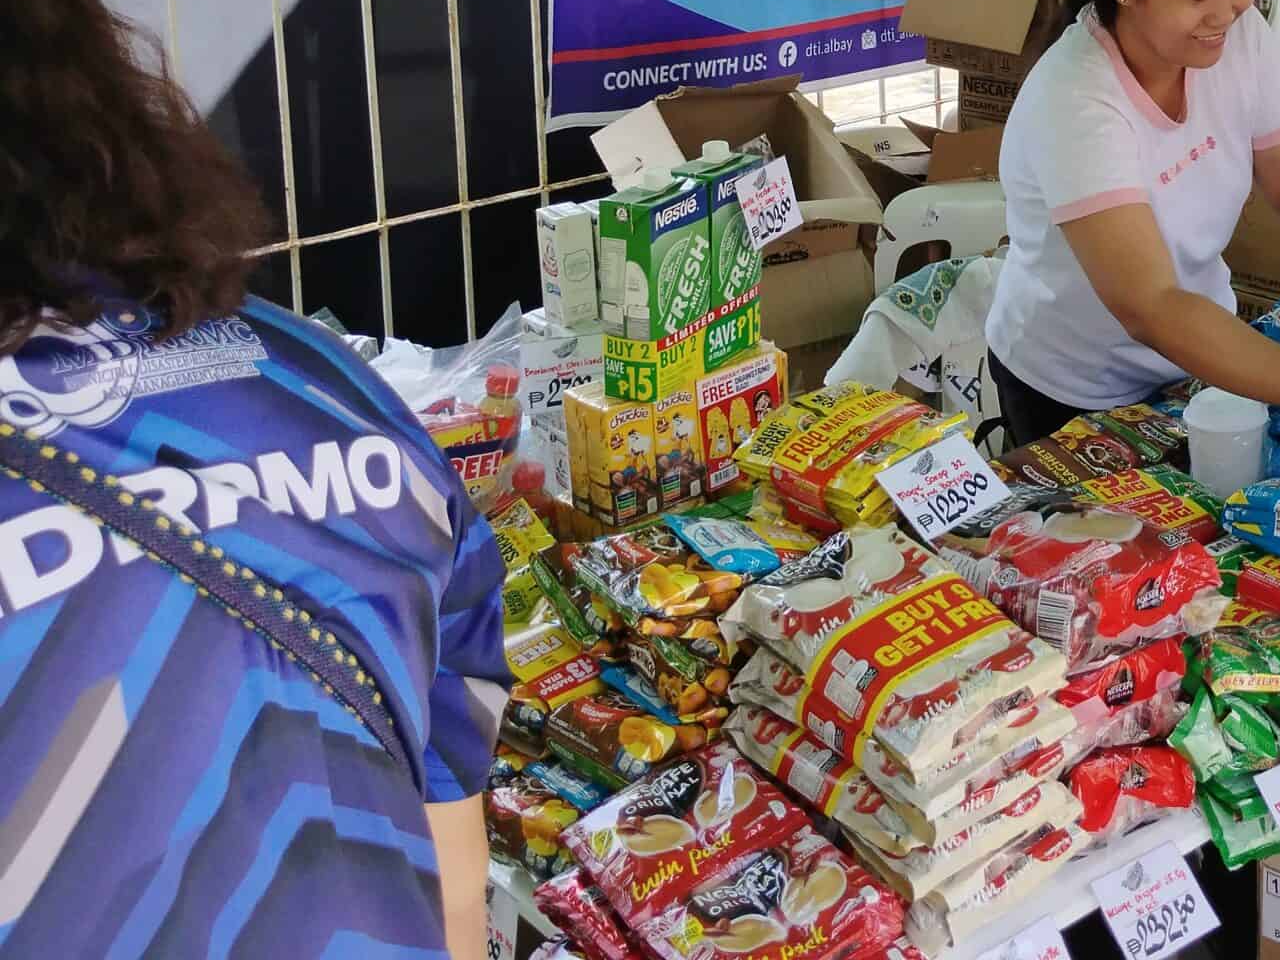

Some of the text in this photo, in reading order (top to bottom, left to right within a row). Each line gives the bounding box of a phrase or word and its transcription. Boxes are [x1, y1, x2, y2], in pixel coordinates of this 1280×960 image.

[603, 60, 691, 91] CONNECT
[694, 55, 741, 80] WITH
[741, 51, 768, 74] US:
[805, 36, 854, 58] dti.albay
[716, 178, 738, 202] Nes
[664, 234, 711, 335] FRESH
[664, 311, 716, 348] LIMITED
[709, 319, 738, 351] SAVE
[606, 337, 650, 360] BUY 2
[660, 341, 688, 370] BUY
[702, 380, 735, 406] FREE
[886, 590, 953, 631] BUY
[873, 619, 938, 668] GET
[930, 614, 953, 635] 1
[631, 859, 684, 903] twin
